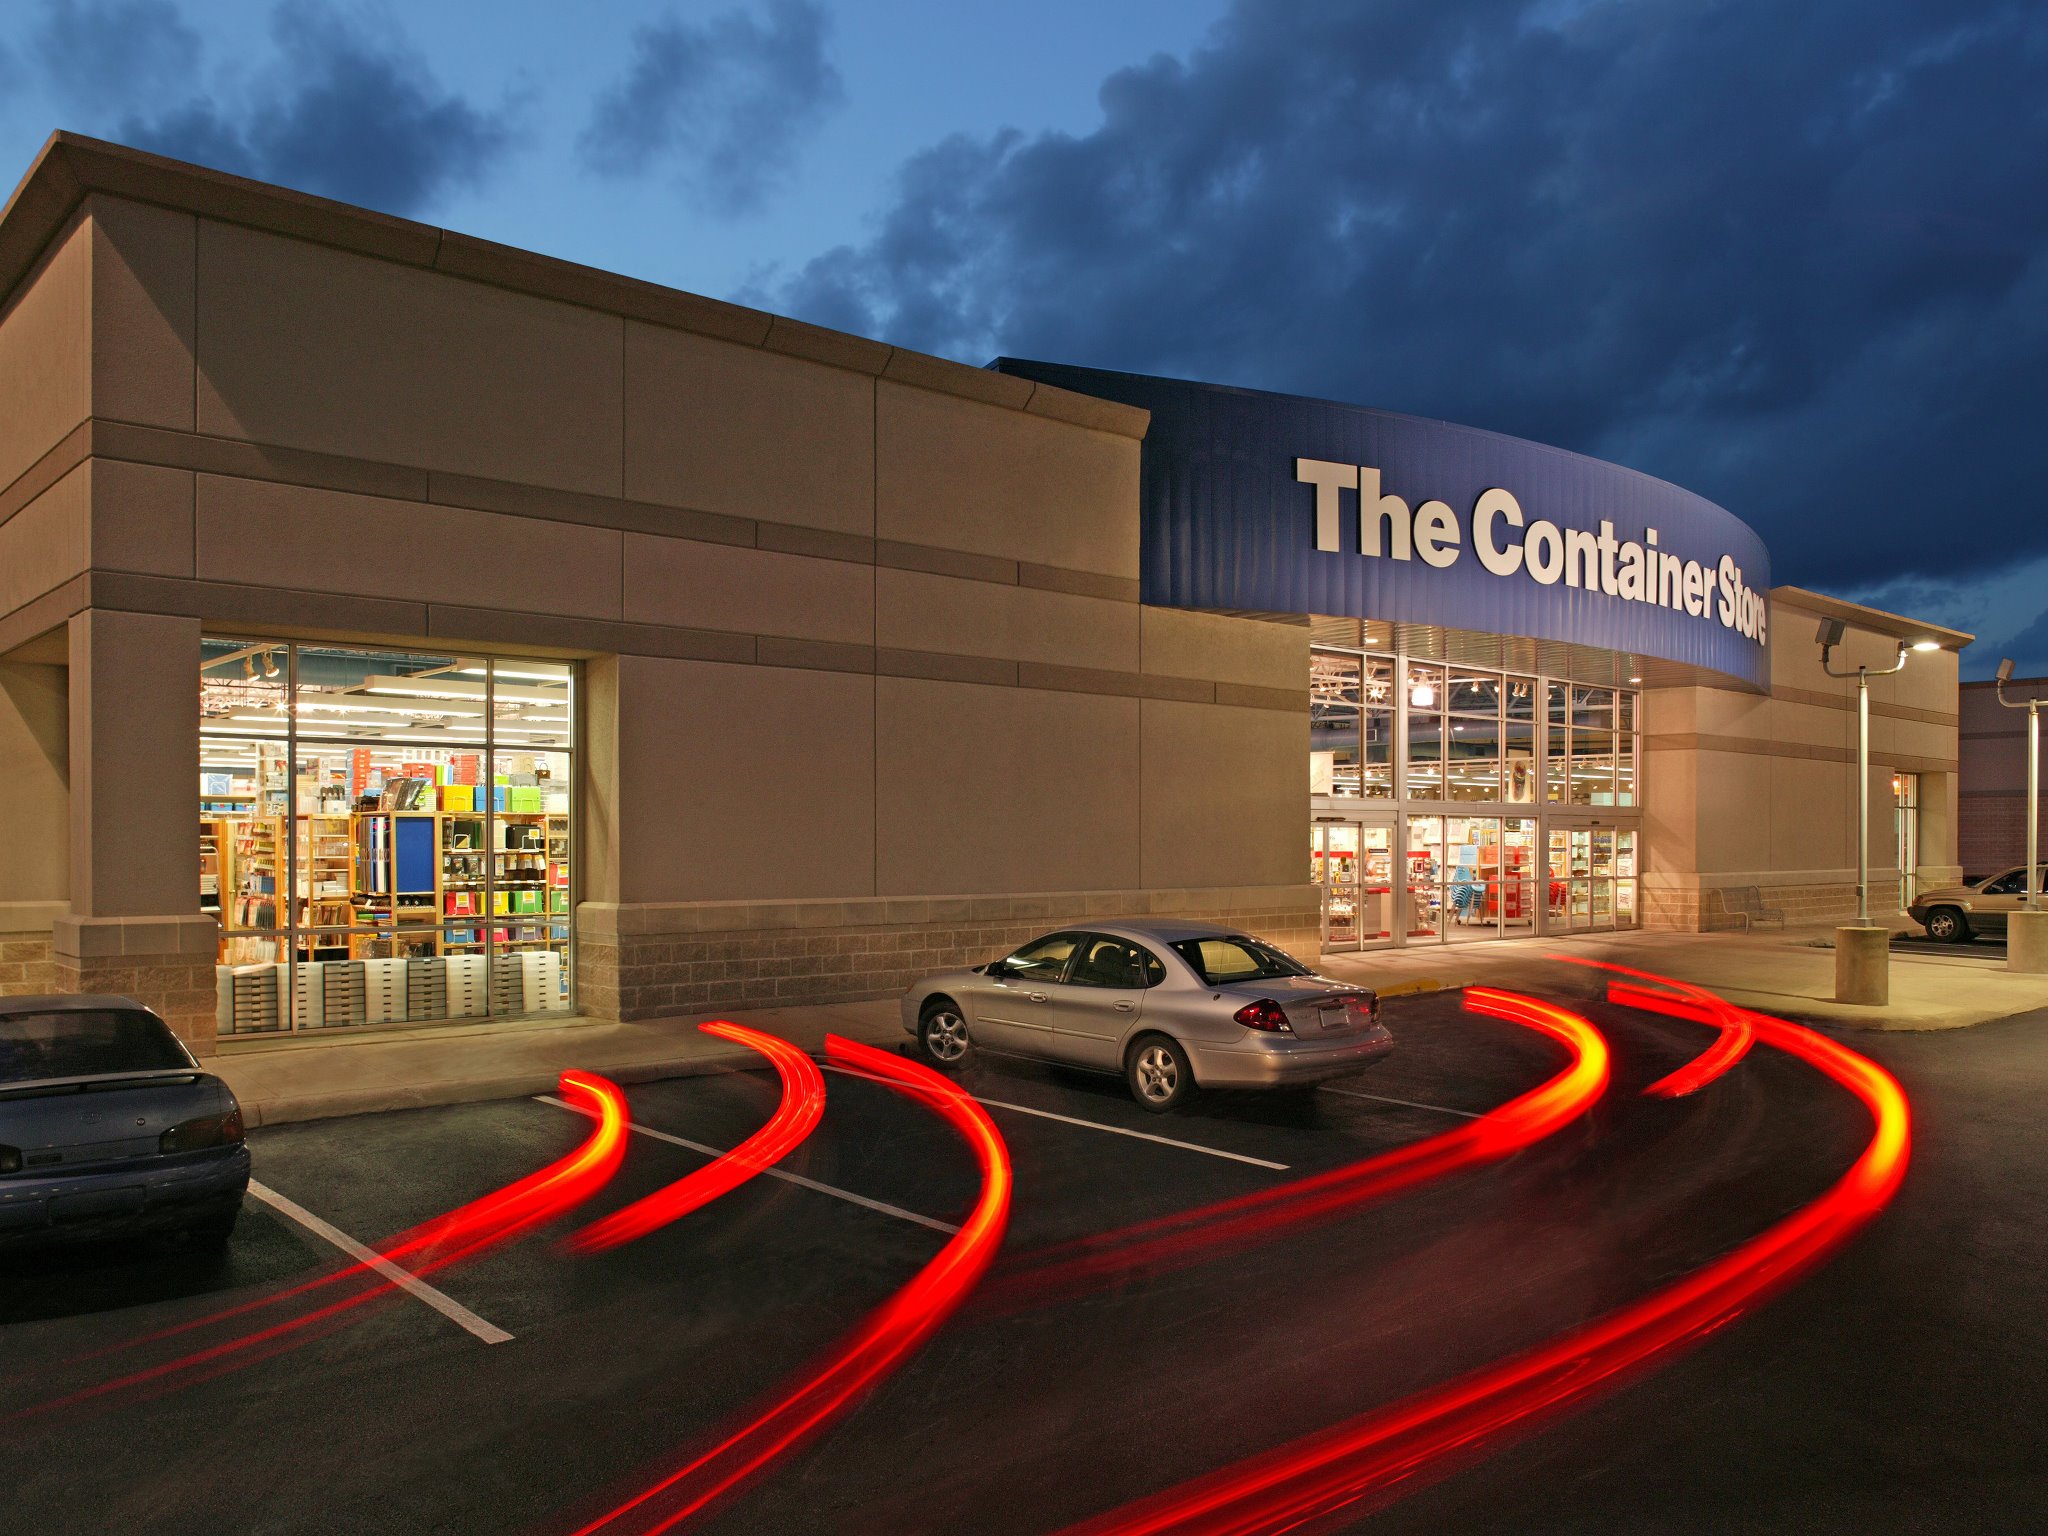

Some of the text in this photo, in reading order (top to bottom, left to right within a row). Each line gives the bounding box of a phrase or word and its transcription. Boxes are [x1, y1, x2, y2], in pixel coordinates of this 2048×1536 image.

[1296, 458, 1766, 647] The Container Store
